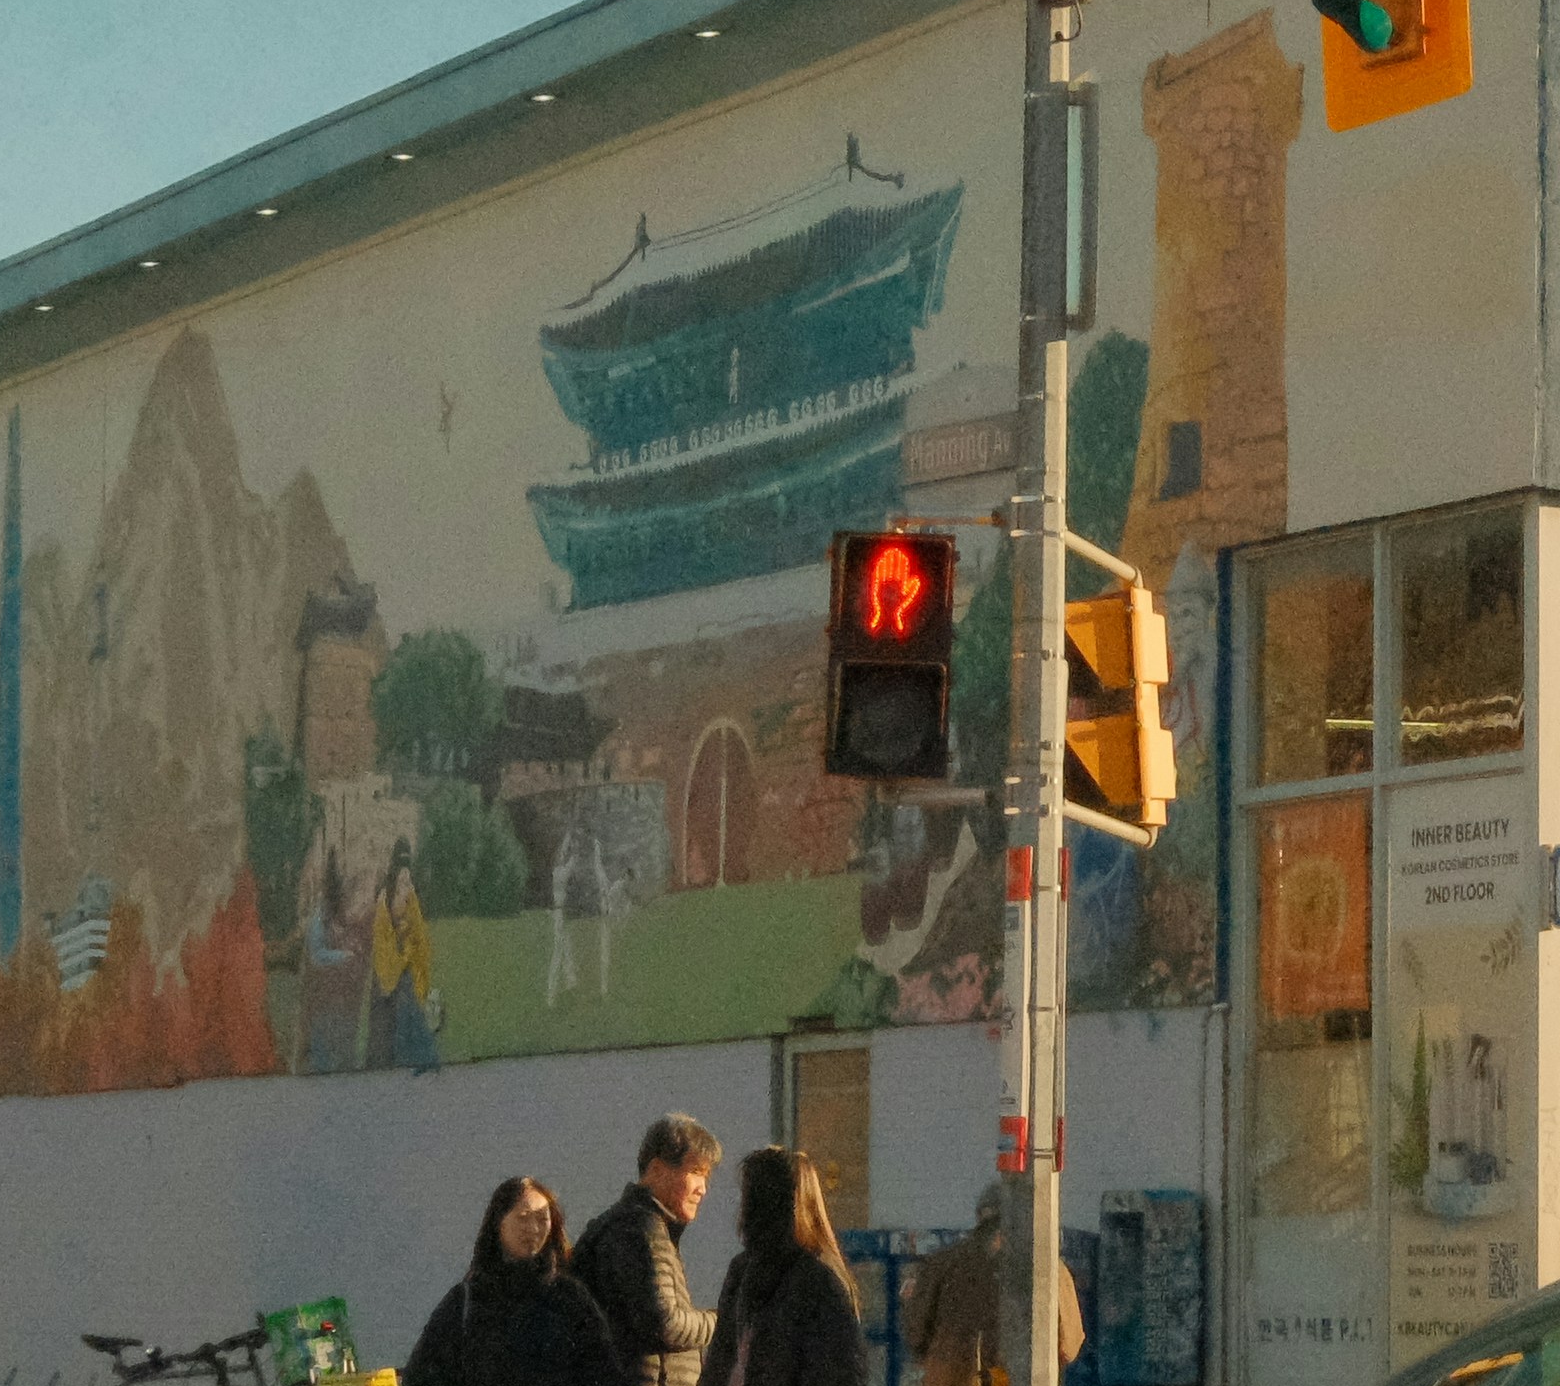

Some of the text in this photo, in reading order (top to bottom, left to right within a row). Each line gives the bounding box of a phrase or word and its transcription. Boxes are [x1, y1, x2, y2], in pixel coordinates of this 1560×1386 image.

[1411, 818, 1510, 848] INNER BEAUTY
[1438, 855, 1490, 872] COSMETICS
[1491, 852, 1520, 867] STORE
[1425, 881, 1495, 905] 2ND FLOOR
